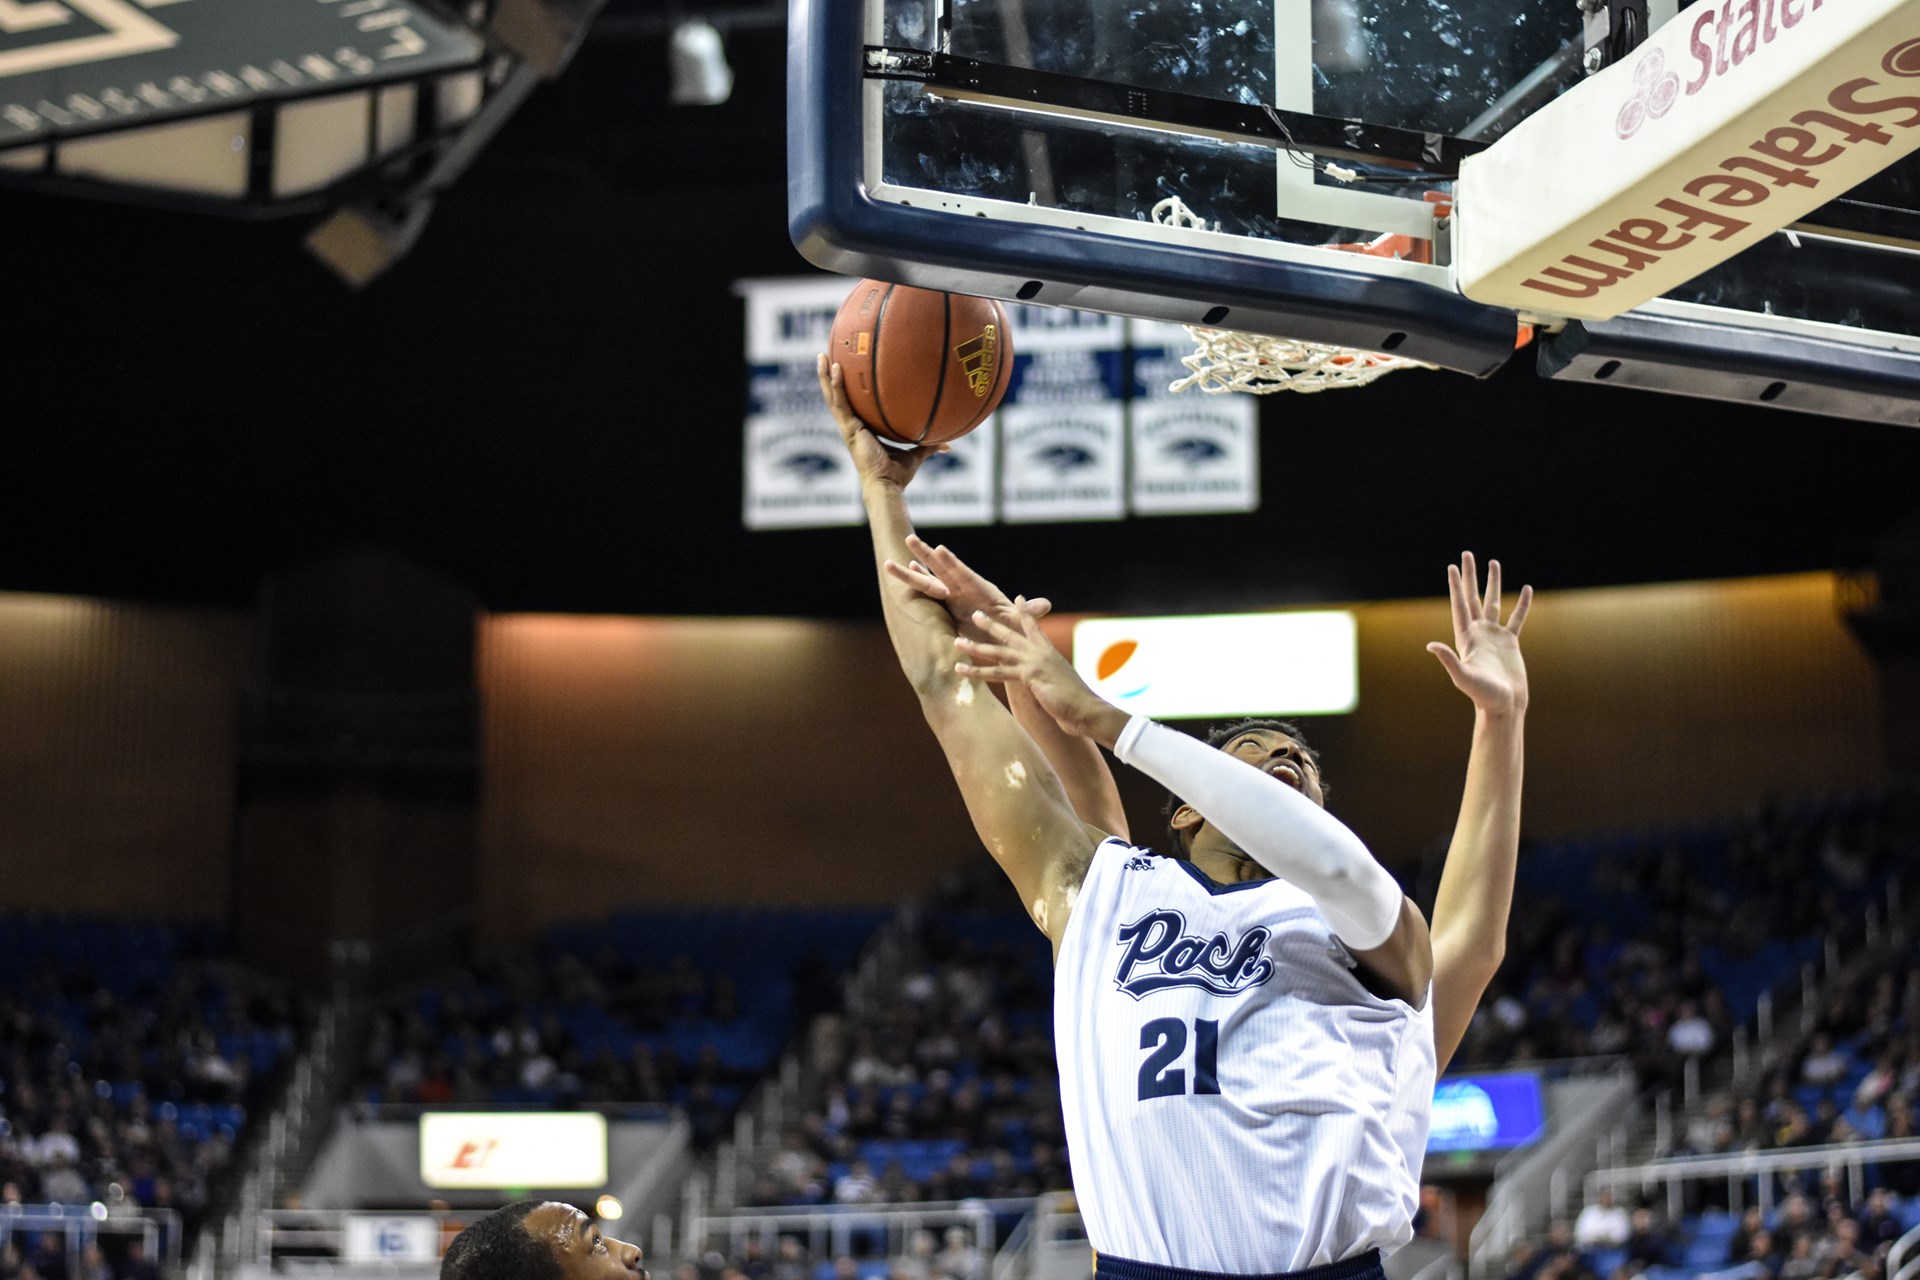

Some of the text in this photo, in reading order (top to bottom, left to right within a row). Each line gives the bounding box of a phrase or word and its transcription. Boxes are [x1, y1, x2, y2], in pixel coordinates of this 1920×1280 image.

[973, 324, 996, 397] adidas
[1114, 908, 1275, 1001] Pack
[1138, 1017, 1221, 1101] 21
